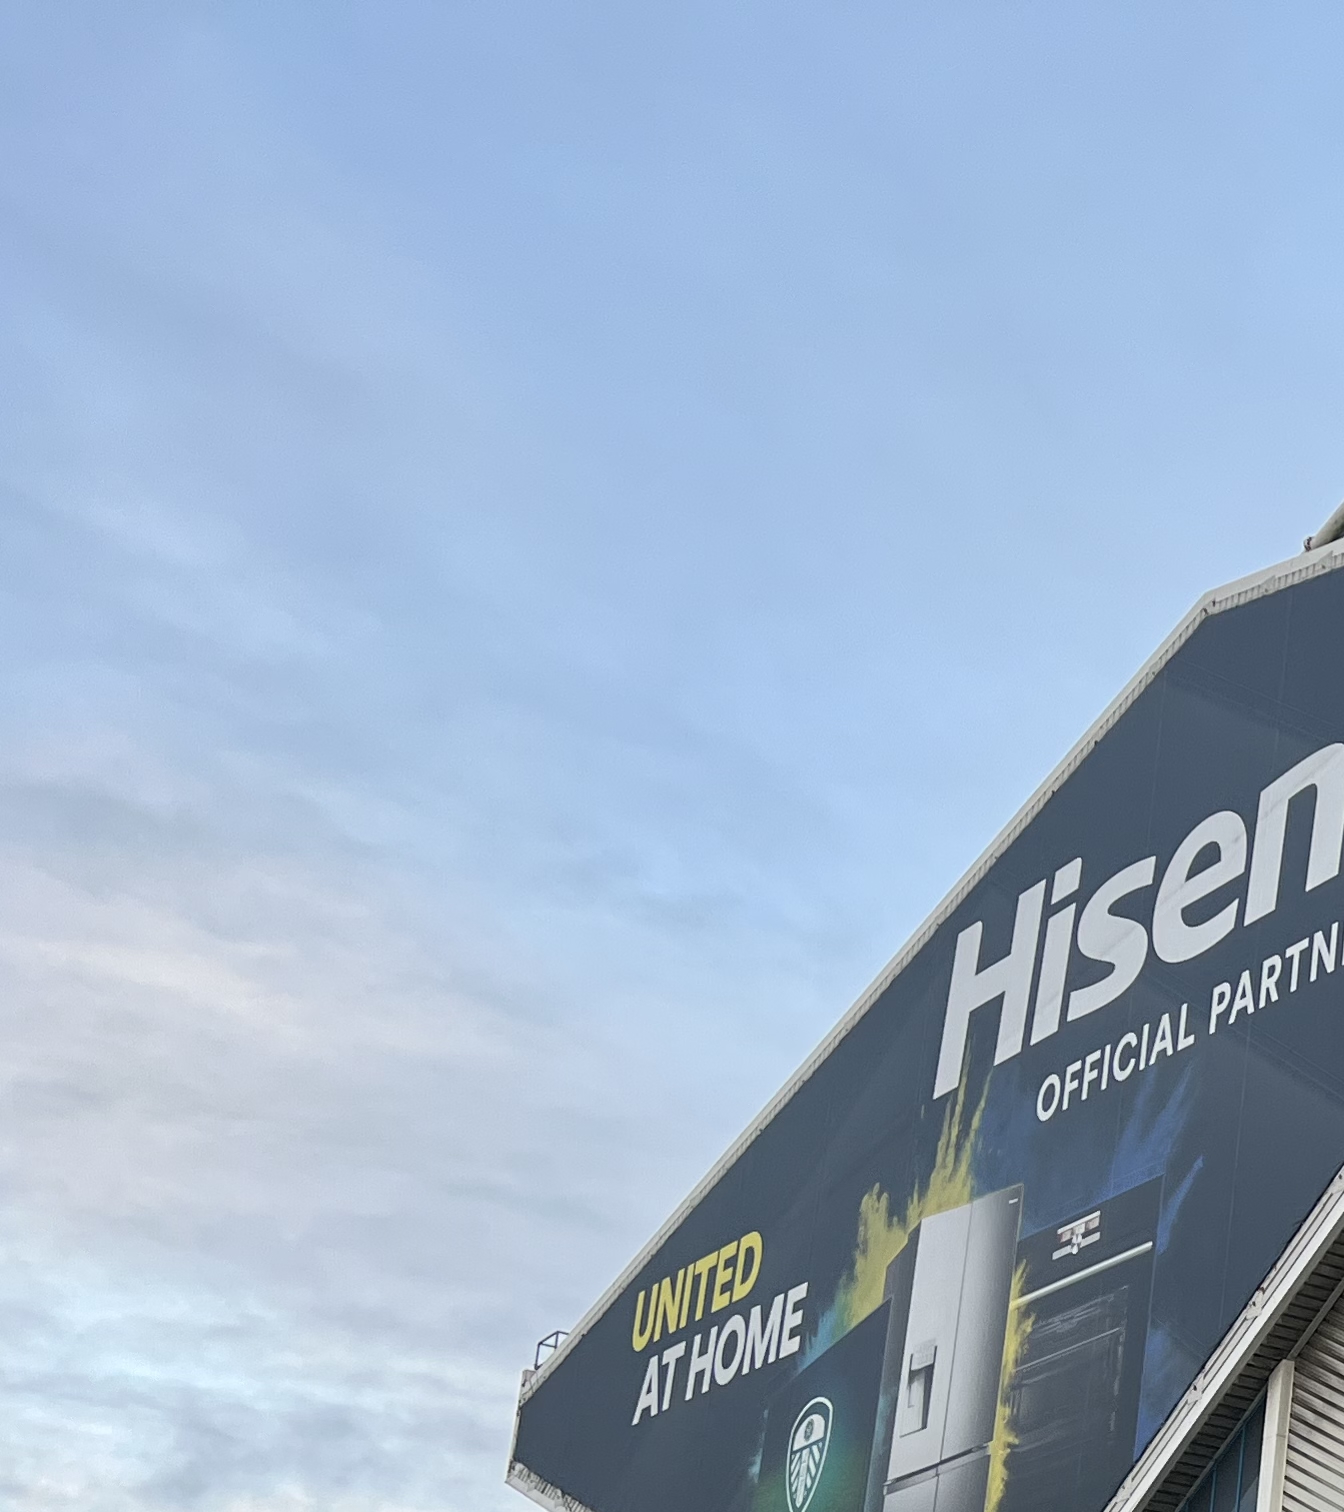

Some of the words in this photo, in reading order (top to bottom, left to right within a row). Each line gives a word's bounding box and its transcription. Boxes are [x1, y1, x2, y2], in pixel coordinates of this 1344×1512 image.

[1036, 1003, 1195, 1122] OFFICIAL
[632, 1231, 763, 1353] UNITED
[631, 1341, 687, 1426] AT
[685, 1281, 809, 1401] HOME
